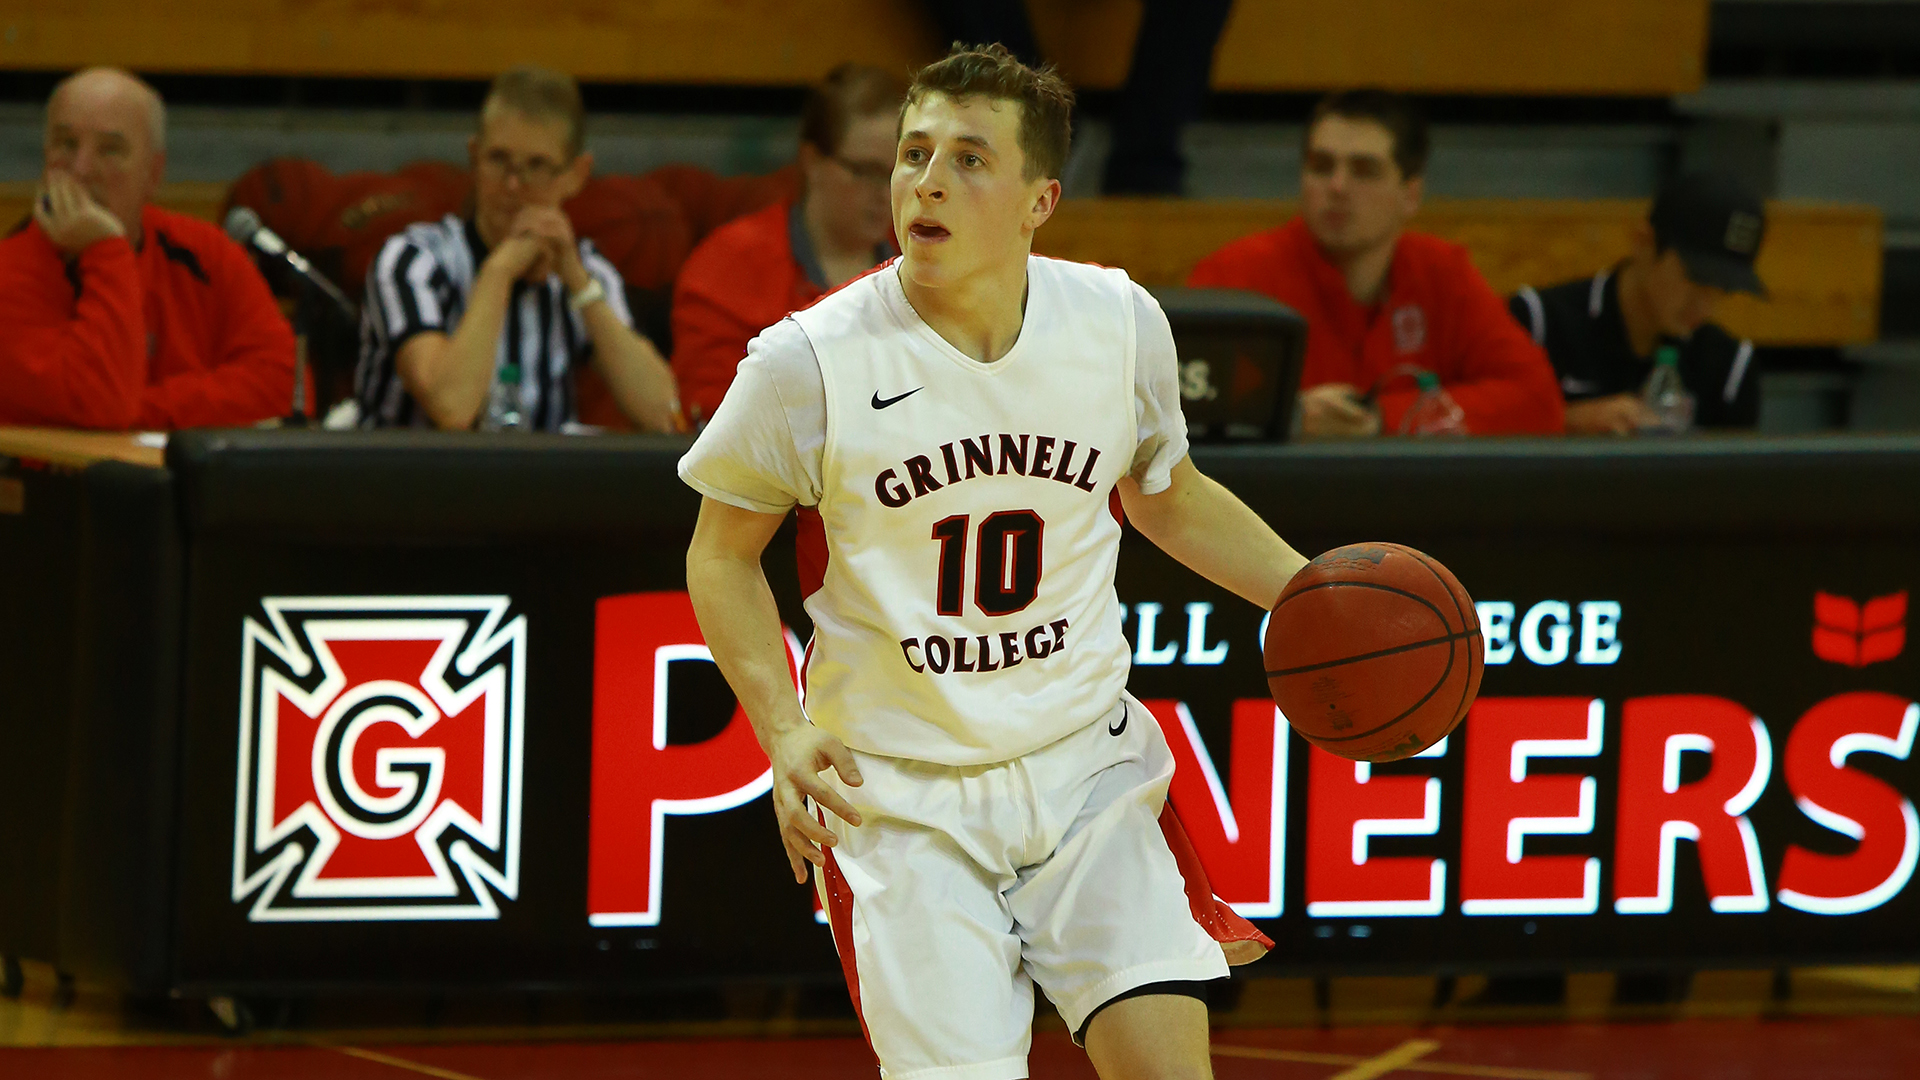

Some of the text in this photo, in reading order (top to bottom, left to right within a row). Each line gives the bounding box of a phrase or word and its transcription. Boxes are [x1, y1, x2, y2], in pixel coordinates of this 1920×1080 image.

[875, 434, 1102, 508] GRINNELL
[931, 509, 1045, 617] 10
[900, 618, 1070, 675] COLLEGE
[315, 683, 443, 837] G
[588, 591, 1920, 926] PNEERS
